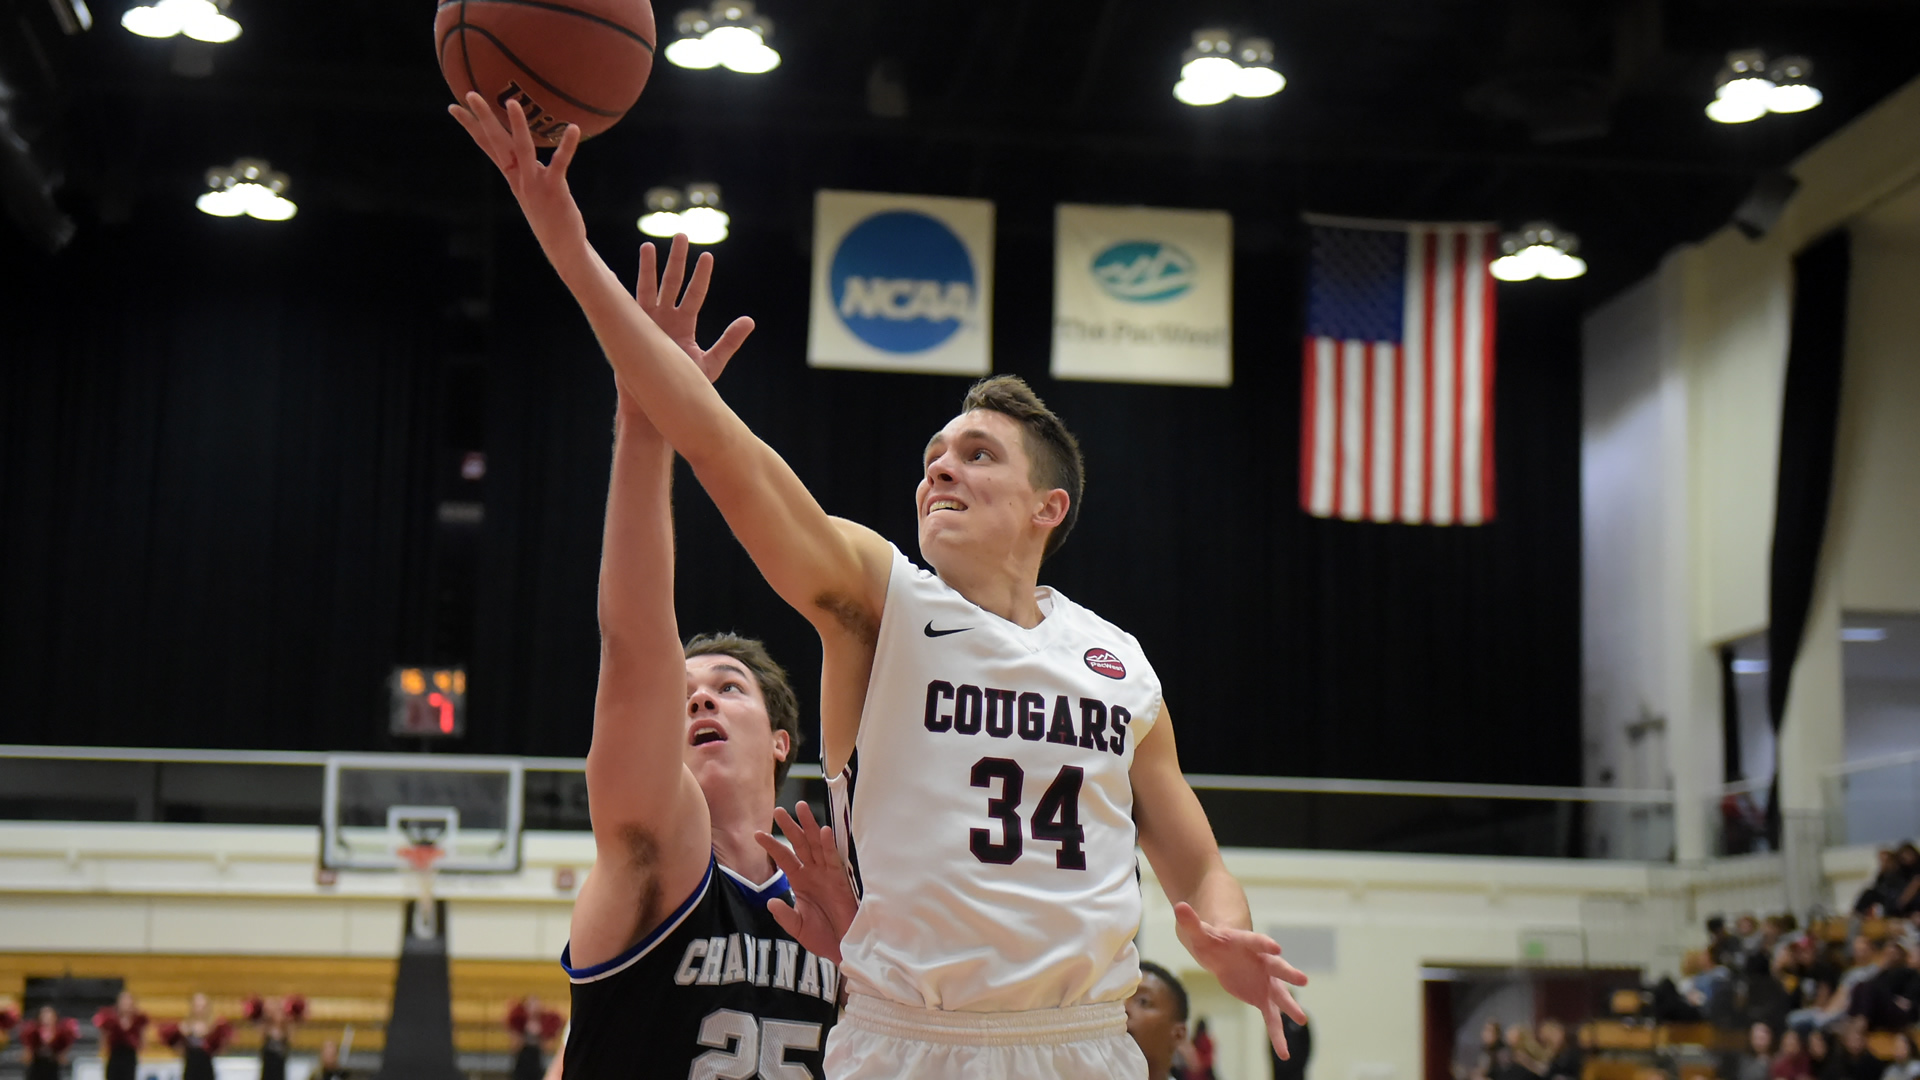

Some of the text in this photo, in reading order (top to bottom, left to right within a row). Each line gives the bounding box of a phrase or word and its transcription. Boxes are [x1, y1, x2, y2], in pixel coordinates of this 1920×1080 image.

[841, 275, 976, 323] NCAA
[1090, 661, 1125, 672] PacWest
[923, 679, 1132, 757] COUGARS
[969, 756, 1087, 871] 34
[687, 1007, 823, 1080] 25
